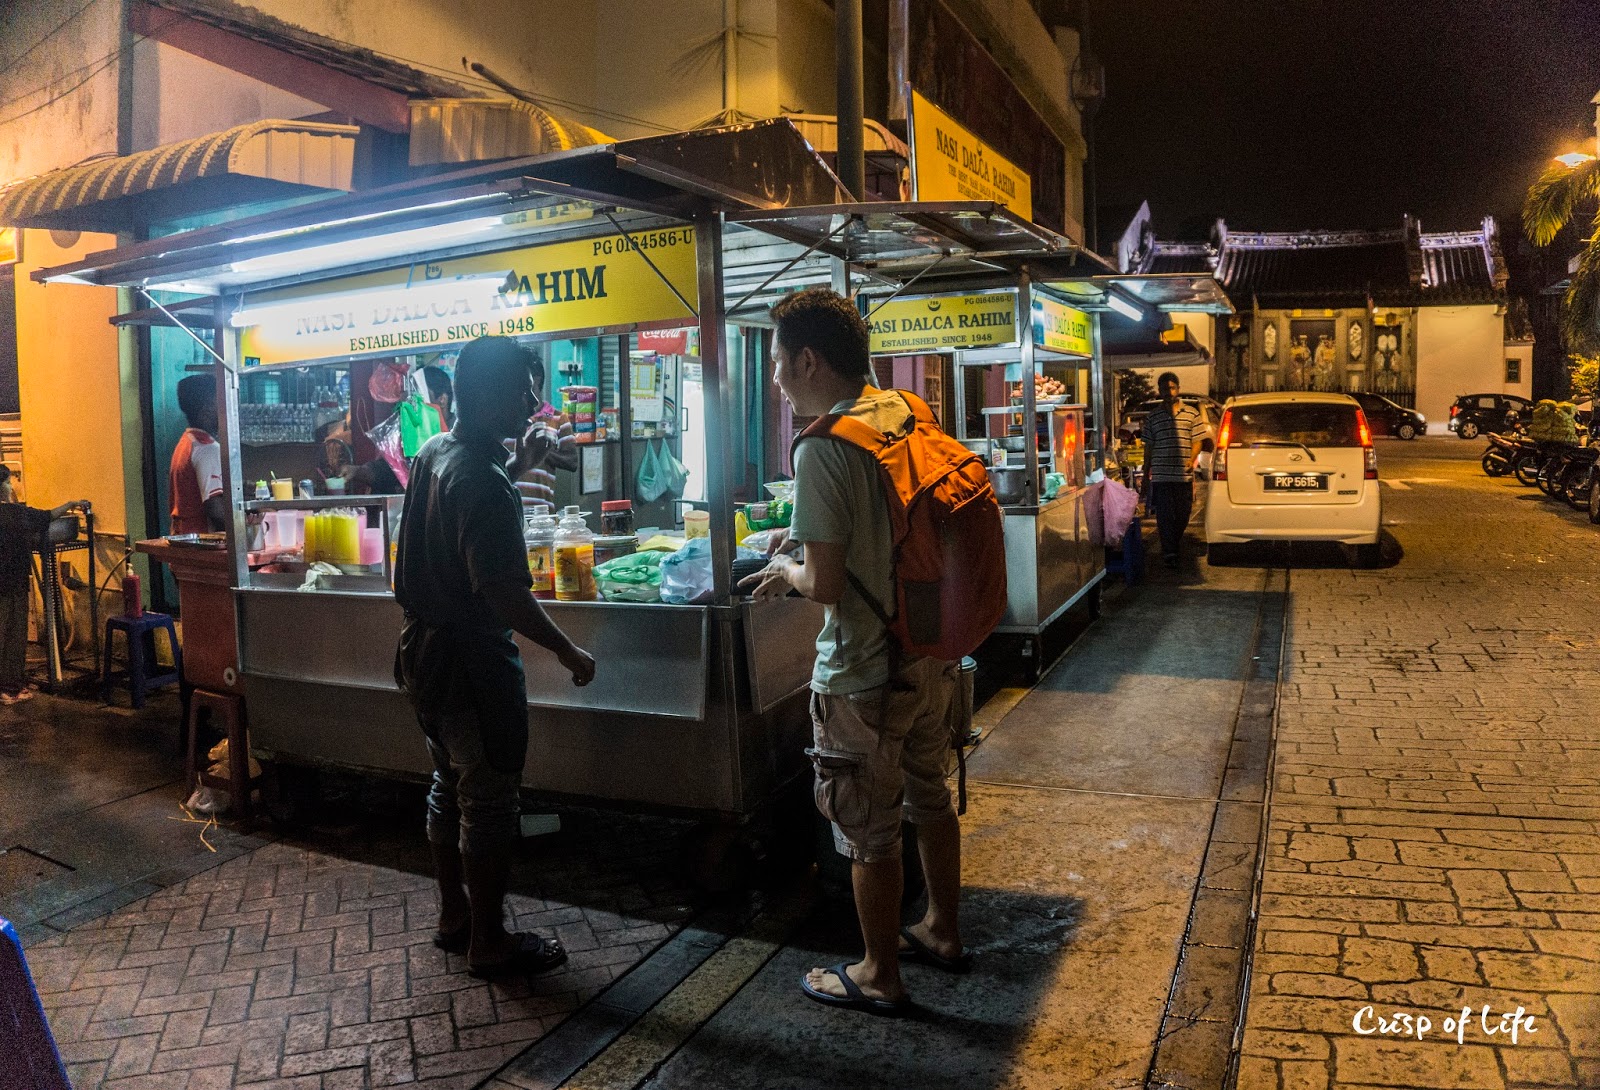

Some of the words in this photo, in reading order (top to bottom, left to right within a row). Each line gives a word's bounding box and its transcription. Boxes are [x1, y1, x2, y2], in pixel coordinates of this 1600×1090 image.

[936, 127, 958, 162] NASI
[962, 145, 990, 182] DALCA
[993, 166, 1016, 199] RAHIM
[593, 240, 613, 256] PG
[296, 311, 356, 336] NASI
[349, 327, 440, 352] ESTABLISHED
[447, 322, 490, 341] SINCE
[499, 316, 535, 335] 1948
[869, 319, 897, 334] ASI
[901, 315, 954, 332] DALCA
[958, 311, 1012, 327] RAHIM
[881, 337, 938, 348] ESTABLISHED
[942, 334, 967, 344] SINCE
[971, 333, 992, 342] 1948
[1275, 476, 1293, 487] PKP
